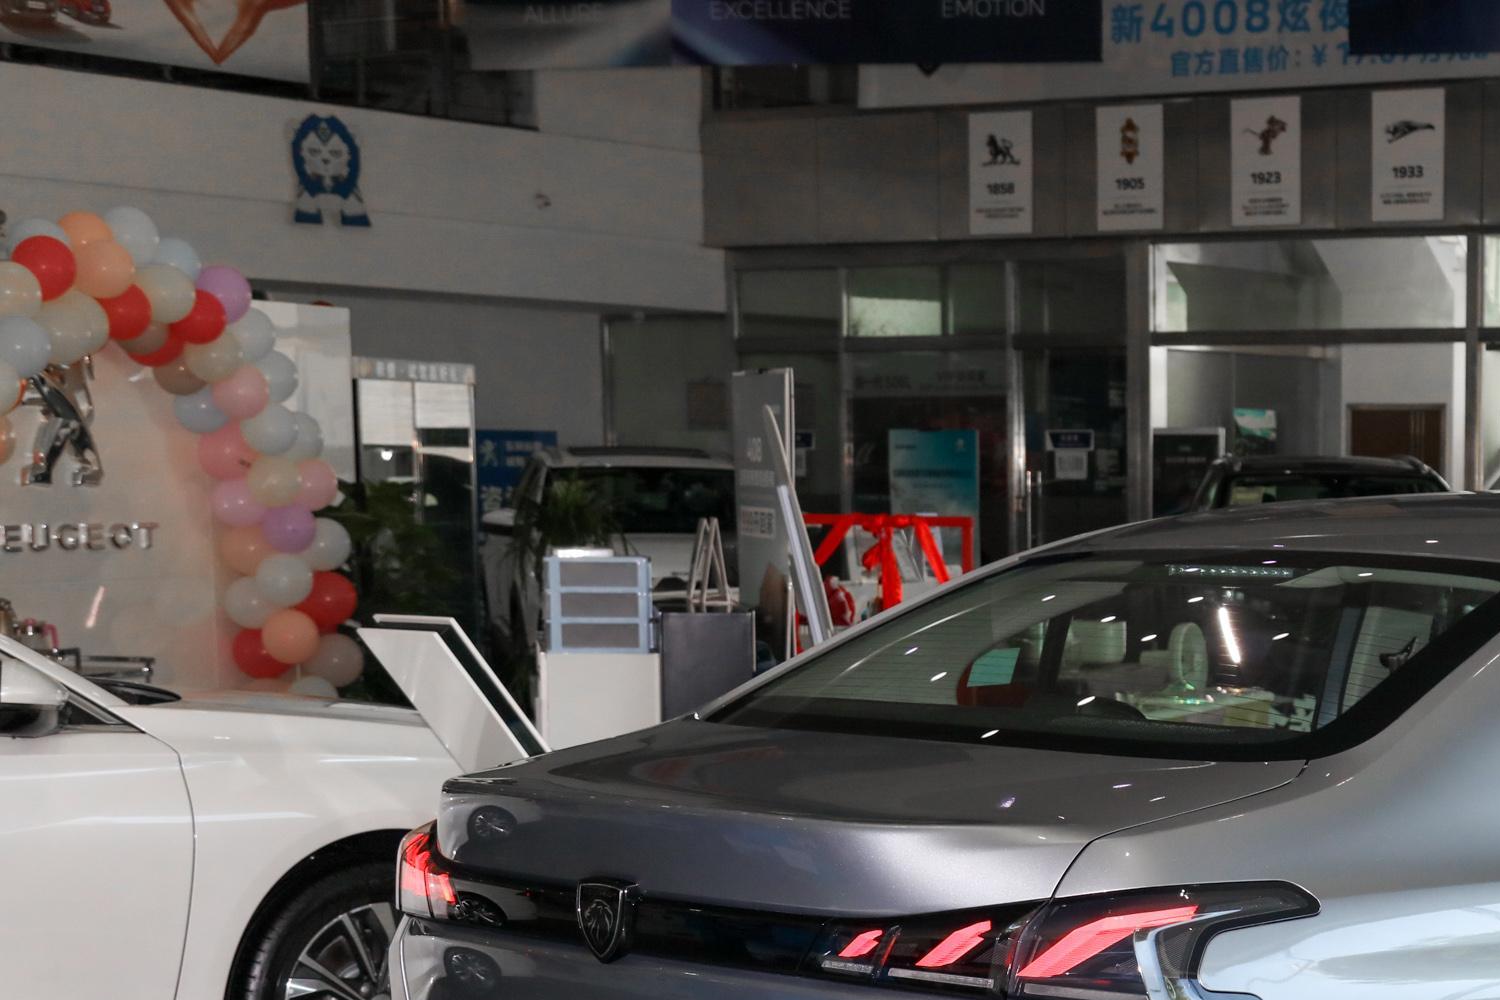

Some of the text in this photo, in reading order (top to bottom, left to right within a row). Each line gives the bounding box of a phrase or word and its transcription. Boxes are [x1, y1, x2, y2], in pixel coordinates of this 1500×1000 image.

[711, 0, 850, 20] EXCELLENCE
[941, 0, 1044, 18] EMOTION
[1251, 171, 1282, 185] 1923
[1392, 165, 1424, 179] 1933
[1115, 177, 1145, 191] 1905
